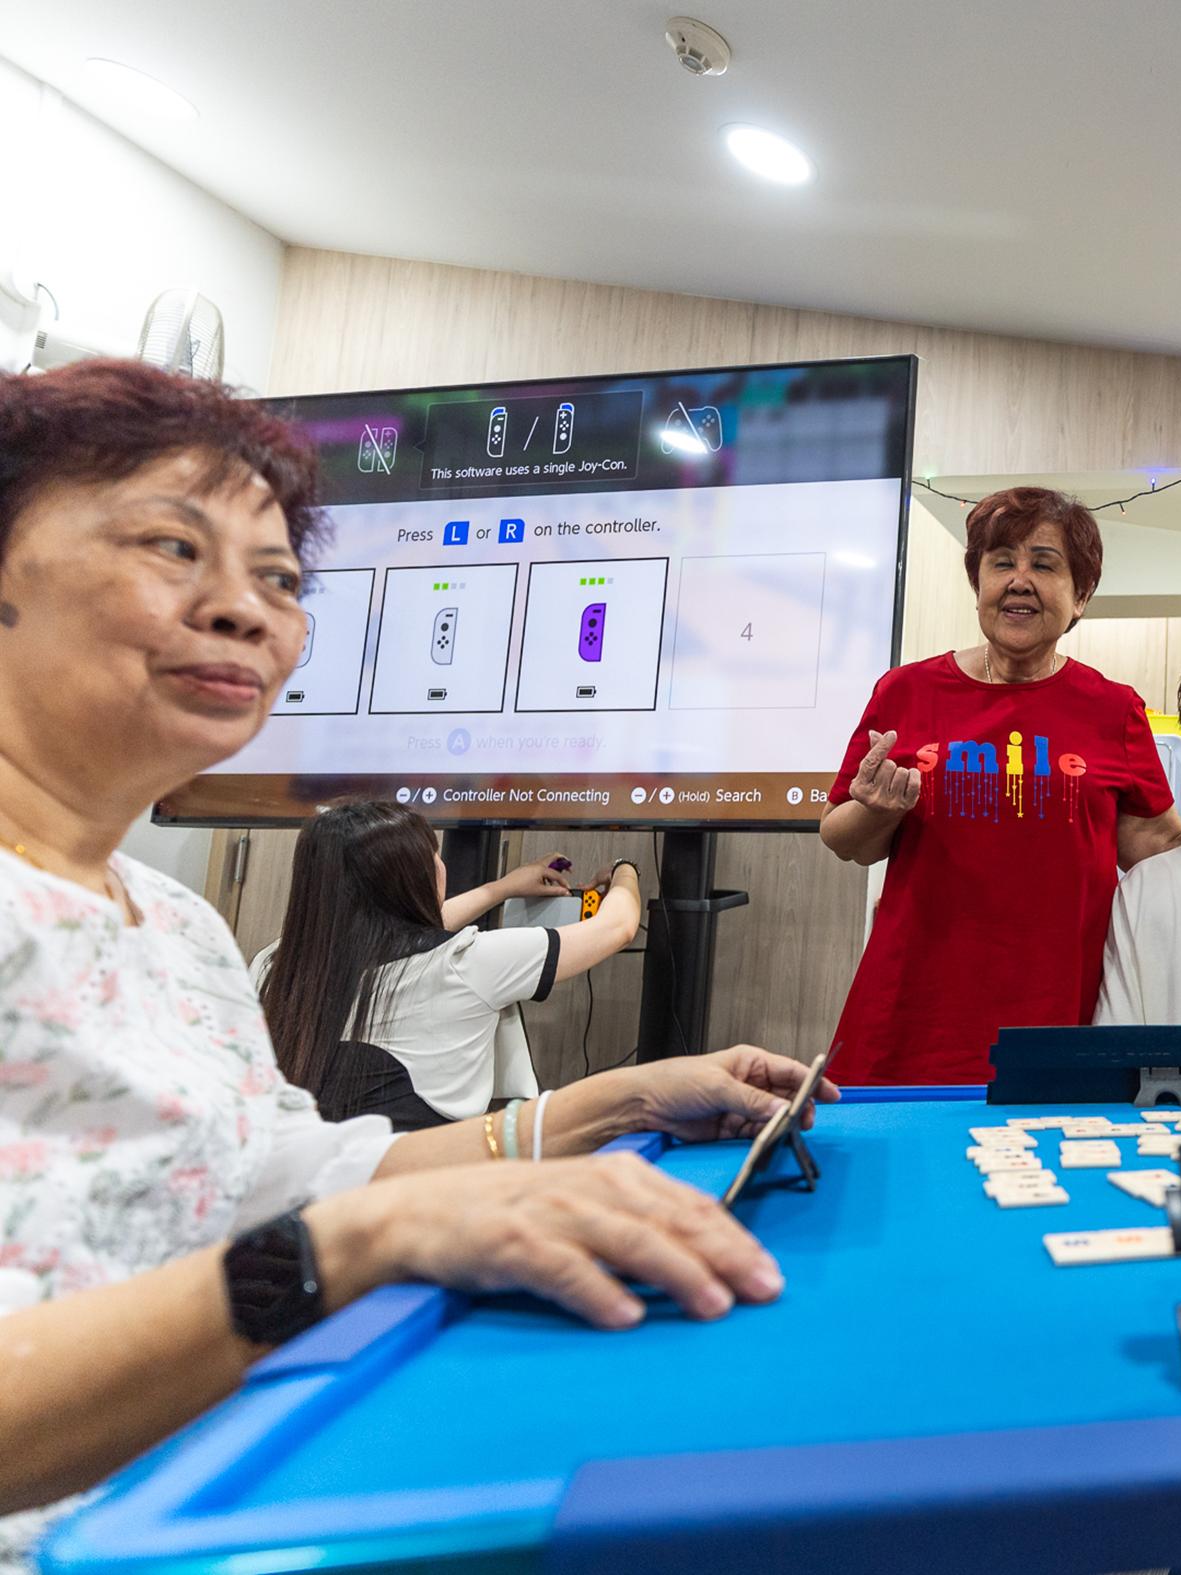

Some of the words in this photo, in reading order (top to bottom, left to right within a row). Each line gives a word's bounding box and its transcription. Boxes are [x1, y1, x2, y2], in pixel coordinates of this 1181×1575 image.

[431, 468, 453, 480] This
[455, 466, 502, 478] software
[505, 465, 530, 476] uses
[533, 465, 540, 474] a
[543, 461, 576, 476] single
[578, 459, 627, 473] Joy-Con.
[398, 528, 434, 543] Press
[476, 527, 491, 540] or
[534, 524, 552, 536] on
[557, 521, 581, 536] the
[585, 518, 661, 535] controller.
[740, 621, 754, 641] 4
[407, 735, 441, 750] Press
[476, 734, 514, 749] when
[518, 735, 560, 752] you're
[563, 733, 607, 751] ready.
[916, 731, 1087, 776] smile
[443, 788, 506, 802] Controller
[509, 788, 534, 802] Not
[537, 788, 610, 806] Connecting
[678, 790, 711, 805] (Hold)
[715, 788, 762, 803] Search
[810, 788, 829, 802] Ba
